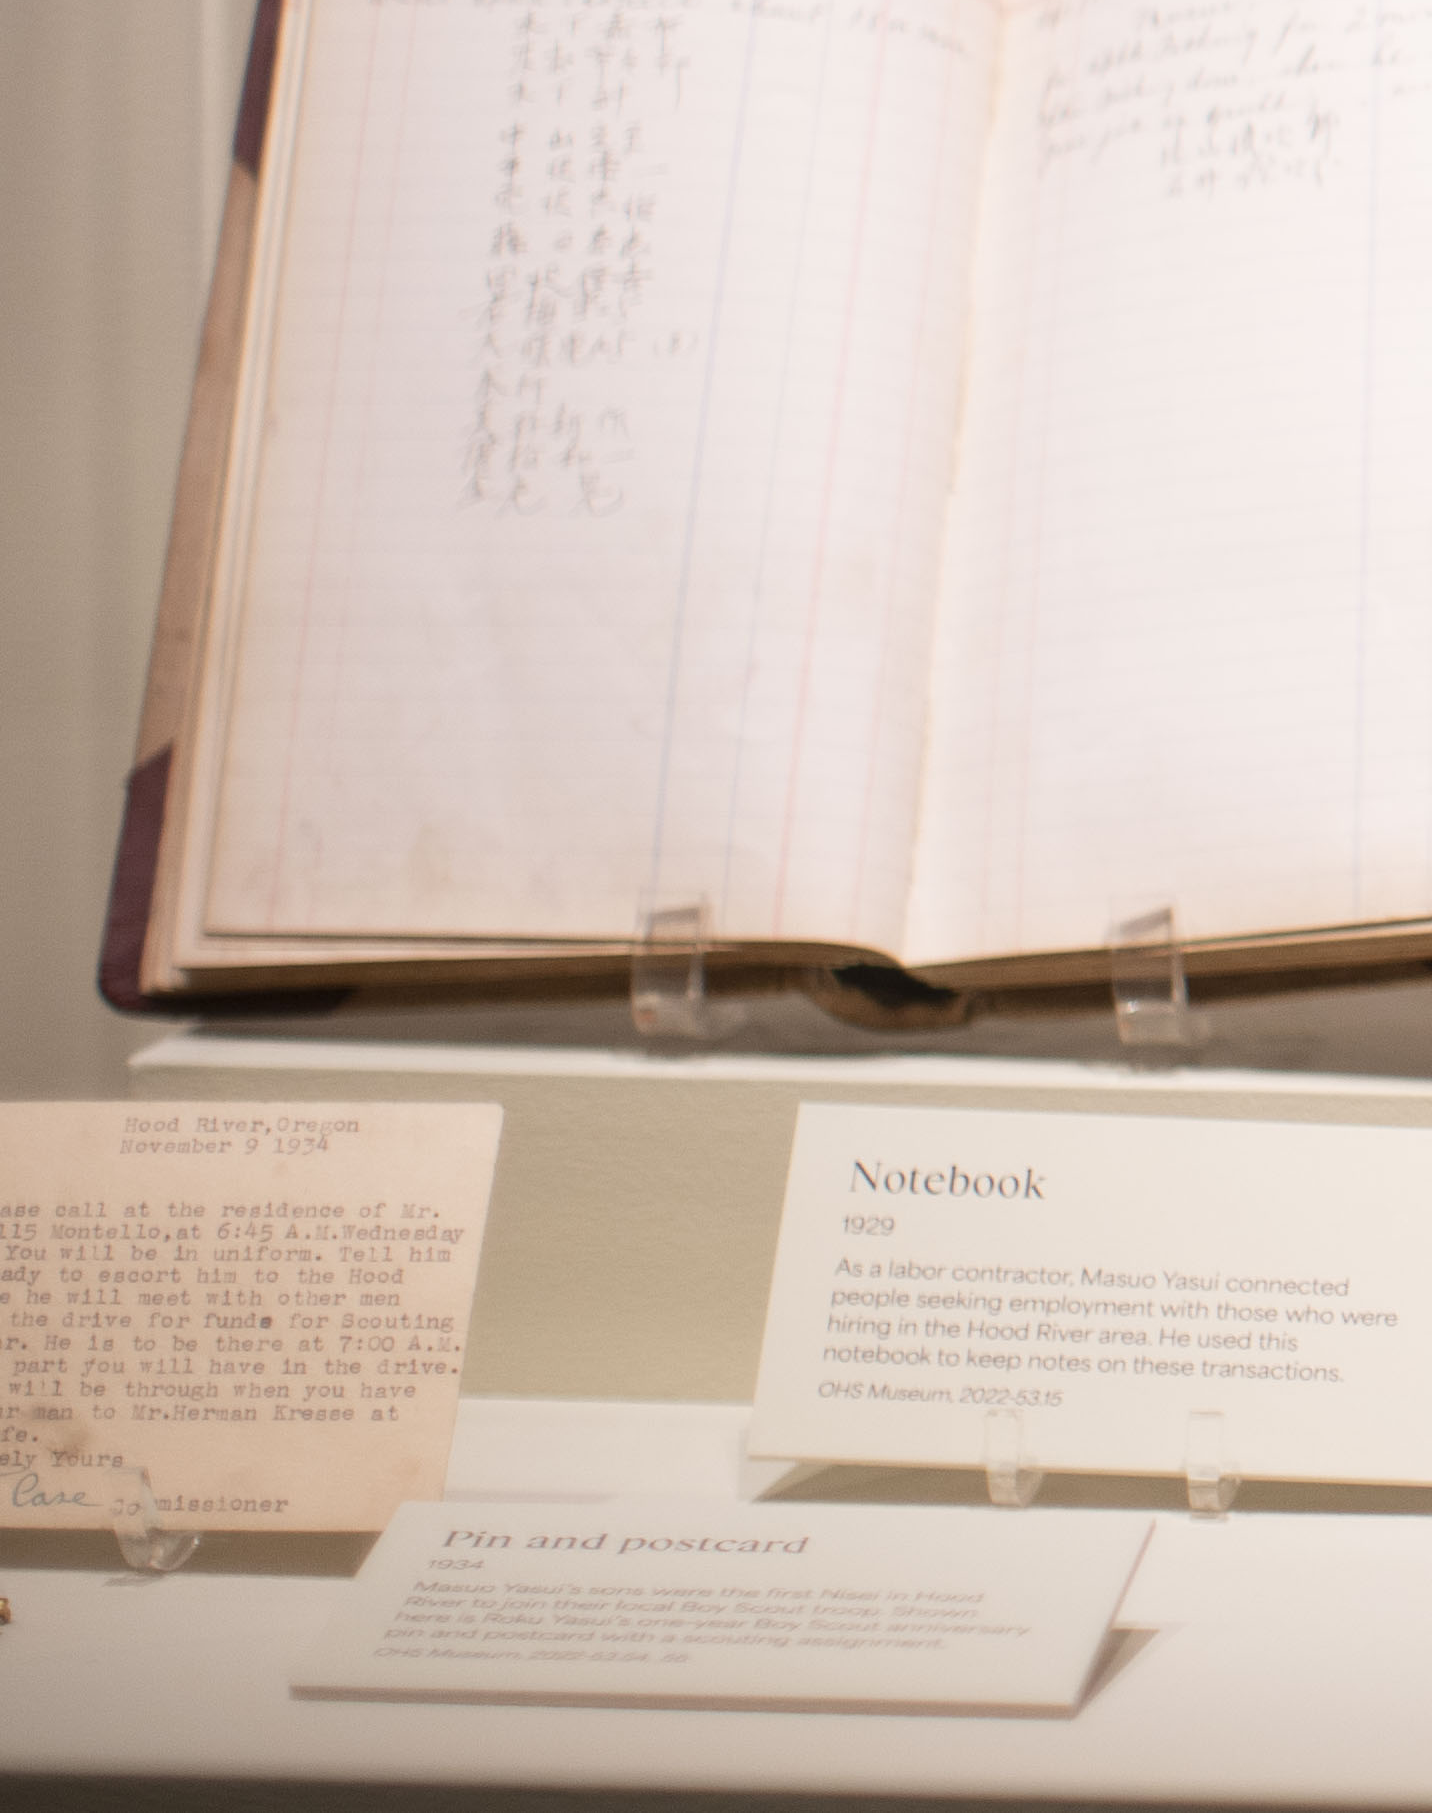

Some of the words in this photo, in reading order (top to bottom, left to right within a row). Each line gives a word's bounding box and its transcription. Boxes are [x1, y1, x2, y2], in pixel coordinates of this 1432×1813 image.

[124, 1116, 179, 1133] Hood
[119, 1137, 232, 1154] November
[244, 1138, 259, 1155] 9
[273, 1135, 329, 1154] 1934
[849, 1158, 1047, 1201] Notebook
[54, 1202, 107, 1219] call
[123, 1203, 150, 1219] at
[167, 1203, 206, 1219] the
[221, 1202, 345, 1219] residence
[359, 1203, 386, 1219] of
[400, 1204, 441, 1220] Mr.
[216, 1223, 273, 1241] 6:45
[842, 1215, 896, 1237] 1929
[4, 1245, 47, 1262] You
[60, 1245, 114, 1262] will
[130, 1246, 158, 1262] be
[174, 1245, 199, 1262] in
[213, 1245, 323, 1262] uniform.
[339, 1246, 394, 1263] Tell
[408, 1246, 451, 1263] him
[835, 1256, 863, 1278] As
[869, 1264, 882, 1278] a
[887, 1258, 946, 1282] labor
[951, 1263, 1075, 1288] contractor,
[1080, 1266, 1157, 1291] Masuo
[1161, 1269, 1220, 1293] Yasui
[1225, 1273, 1350, 1298] connected
[830, 1287, 910, 1312] people
[916, 1290, 1001, 1316] seeking
[1008, 1293, 1155, 1320] employment
[1160, 1298, 1209, 1320] with
[1215, 1300, 1279, 1324] those
[1285, 1303, 1335, 1326] who
[1341, 1309, 1399, 1328] were
[826, 1314, 891, 1341] hiring
[898, 1319, 918, 1337] in
[924, 1318, 961, 1339] the
[967, 1319, 1030, 1342] Hood
[1036, 1324, 1093, 1344] River
[1098, 1328, 1152, 1347] area.
[1158, 1327, 1192, 1348] He
[1197, 1329, 1252, 1351] used
[1258, 1331, 1298, 1353] this
[823, 1343, 931, 1368] notebook
[937, 1348, 959, 1368] to
[966, 1348, 1022, 1374] keep
[1028, 1354, 1092, 1375] notes
[1098, 1359, 1127, 1376] on
[1133, 1355, 1195, 1378] these
[1200, 1359, 1344, 1384] transactions.
[818, 1379, 864, 1401] OHS
[110, 1495, 289, 1515] Comissioner
[441, 1529, 511, 1550] Pin
[525, 1531, 604, 1551] and
[617, 1533, 810, 1556] postcard
[427, 1558, 487, 1571] 1934
